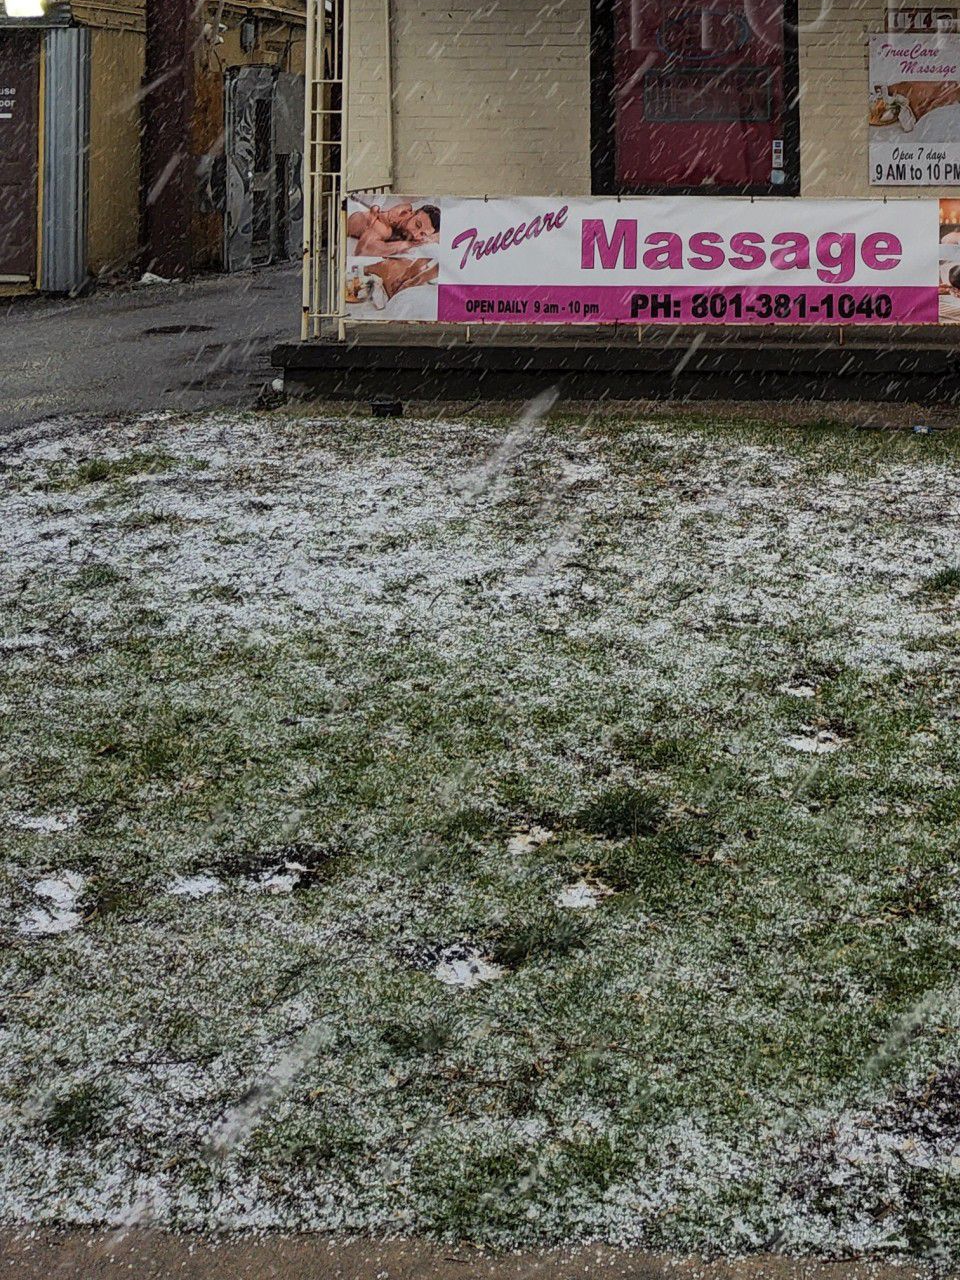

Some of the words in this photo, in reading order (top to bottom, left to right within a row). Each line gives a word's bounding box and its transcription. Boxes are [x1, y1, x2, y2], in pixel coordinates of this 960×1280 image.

[881, 43, 940, 59] TrueCare
[900, 61, 957, 77] Massage
[892, 147, 914, 163] Open
[917, 147, 924, 160] 7
[925, 149, 946, 163] days
[875, 164, 883, 180] 9
[886, 164, 906, 180] AM
[910, 165, 923, 180] to
[926, 164, 941, 180] 10
[452, 205, 569, 269] Truecare
[581, 219, 903, 284] Massage
[465, 299, 495, 314] OPEN
[499, 300, 528, 314] DAILY
[533, 300, 541, 314] 9
[543, 302, 560, 314] am
[568, 300, 581, 314] 10
[583, 303, 599, 317] pm
[630, 294, 681, 318] PH:
[691, 293, 893, 319] 801-381-1040
